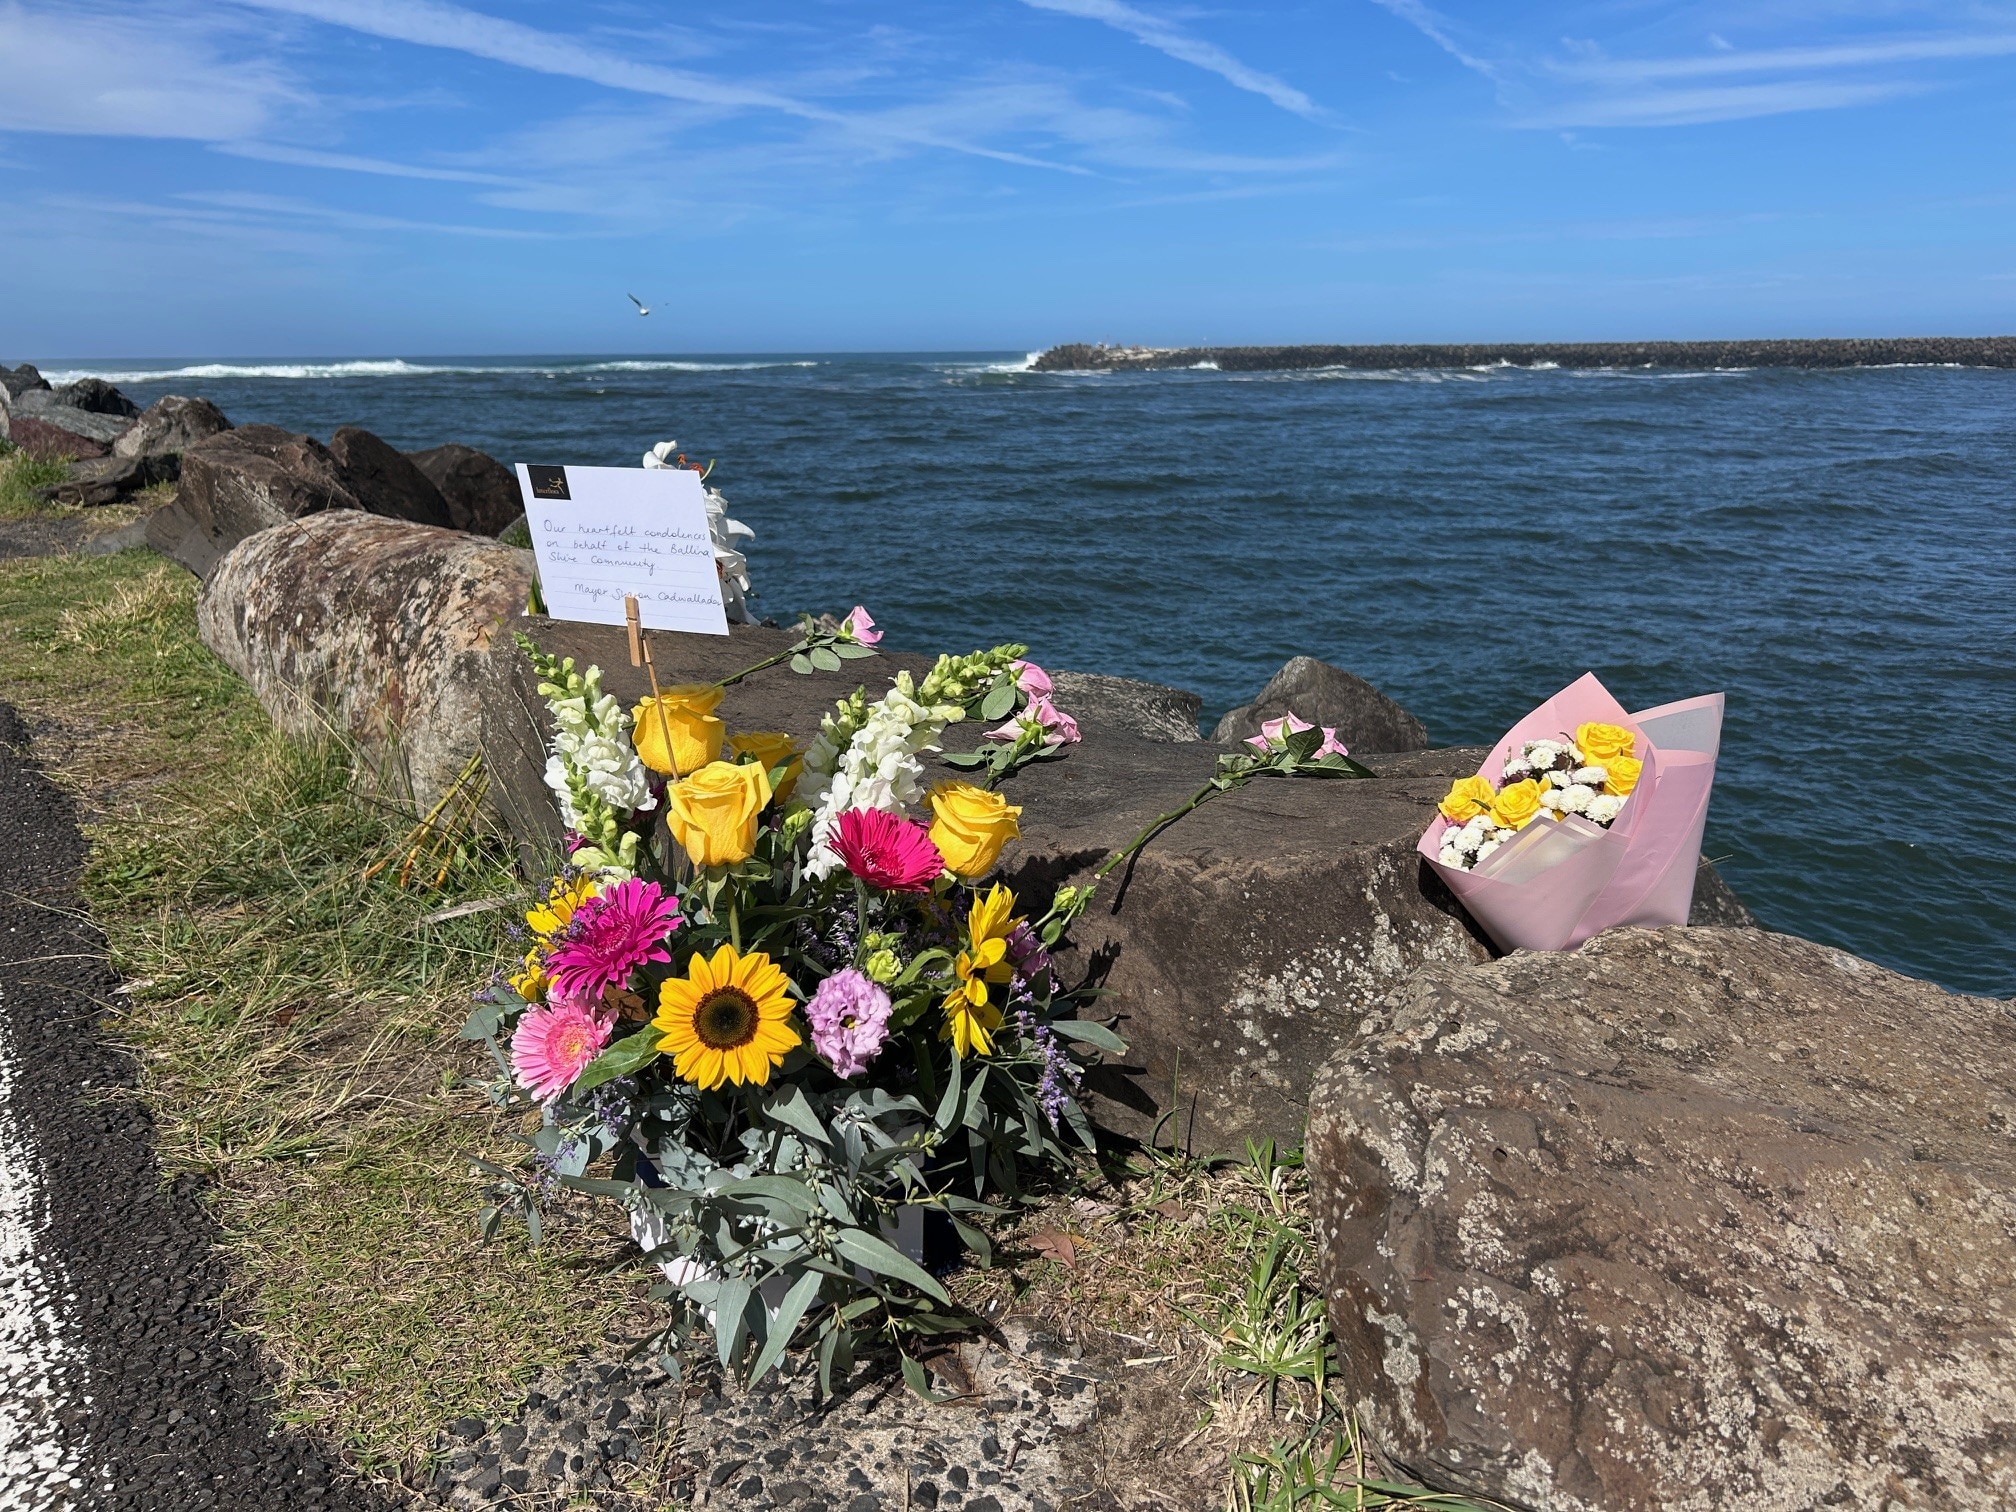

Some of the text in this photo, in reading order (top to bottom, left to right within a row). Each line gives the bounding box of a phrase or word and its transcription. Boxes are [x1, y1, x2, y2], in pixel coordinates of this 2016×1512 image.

[543, 519, 706, 541] Our heartfelt condolences
[546, 540, 710, 558] on behalf of the Ballina
[548, 551, 578, 563] Shire
[574, 583, 608, 602] Mayor
